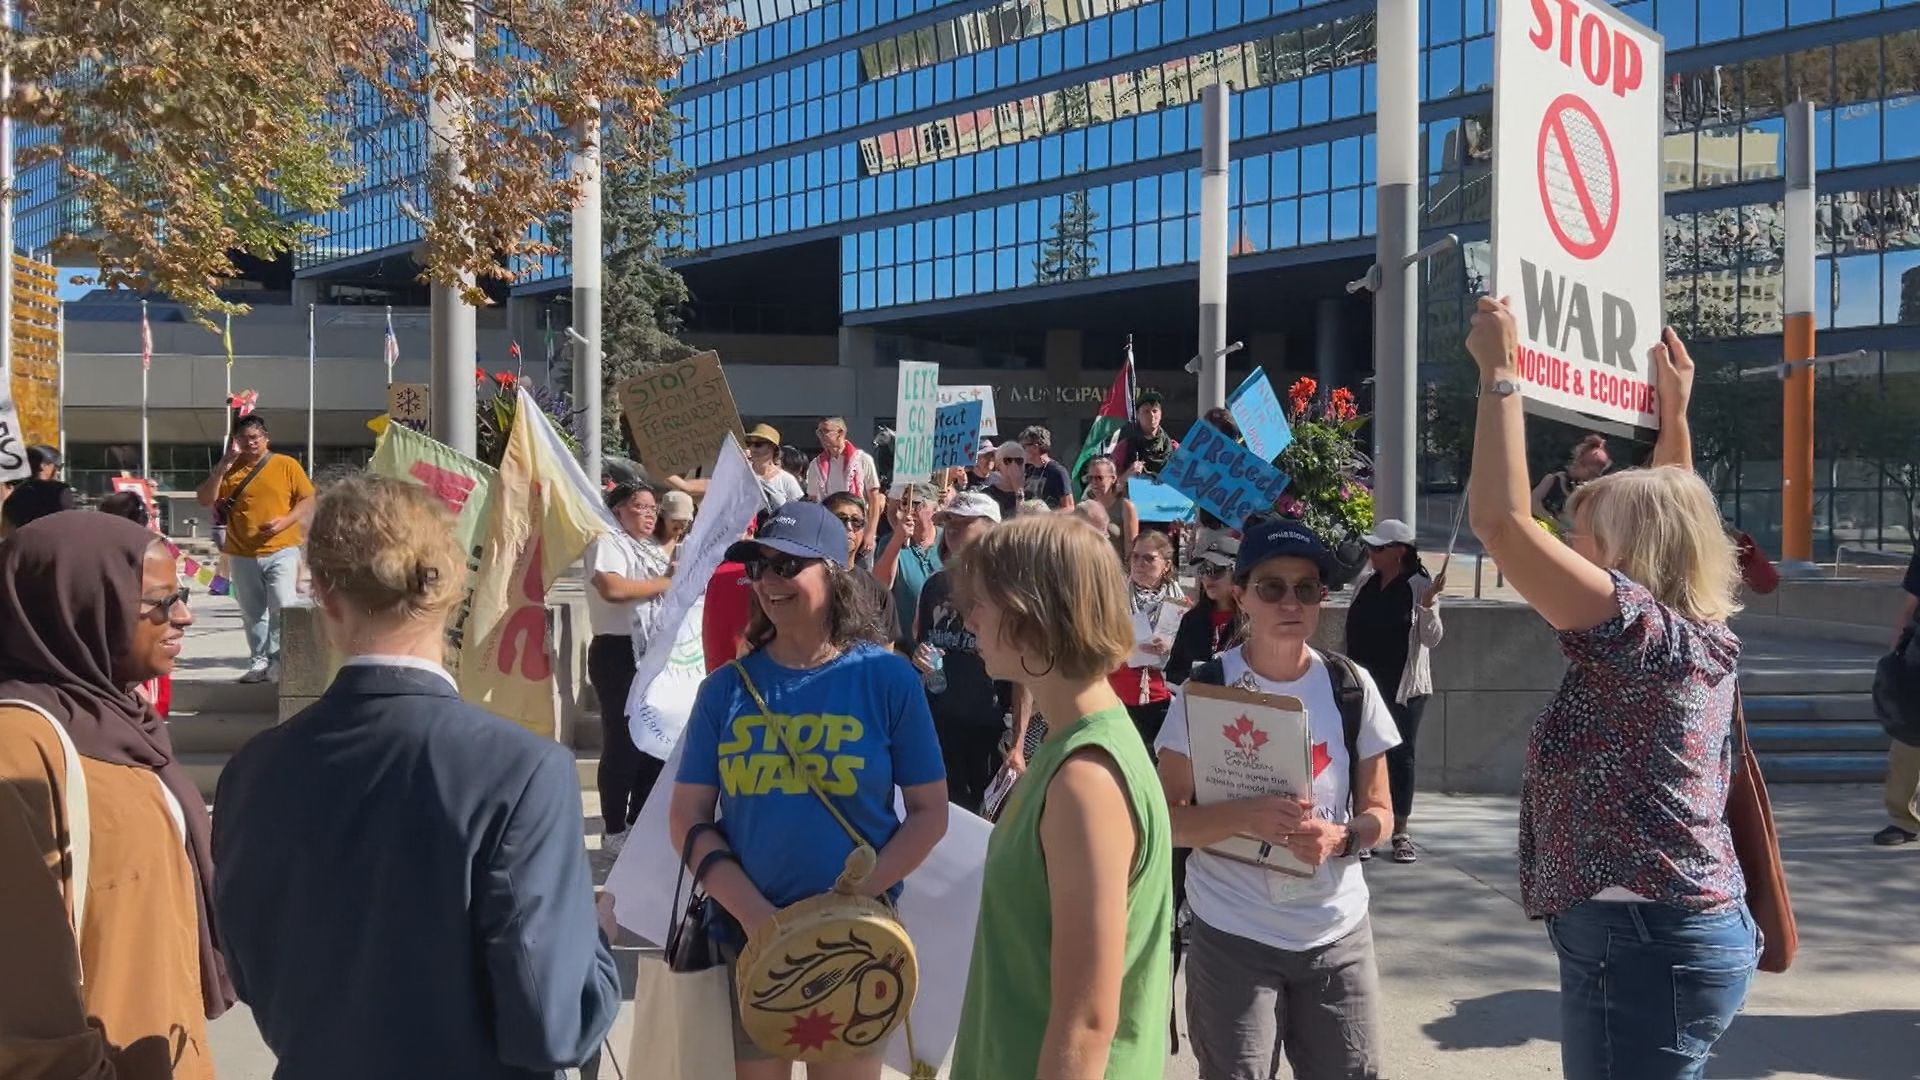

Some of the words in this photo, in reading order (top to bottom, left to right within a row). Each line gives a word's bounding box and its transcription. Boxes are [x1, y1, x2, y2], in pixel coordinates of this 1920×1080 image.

[1528, 0, 1643, 98] STOP
[1519, 257, 1637, 372] WAR
[628, 364, 697, 411] STOP
[904, 369, 937, 400] LET'S
[1516, 344, 1570, 394] NOCIDE
[1572, 369, 1585, 397] &
[1589, 369, 1656, 414] ECOCIDE
[909, 406, 925, 433] GO
[934, 431, 965, 448] ther
[935, 408, 967, 429] tect
[895, 436, 933, 474] SOLAR
[933, 447, 958, 468] rth
[1179, 459, 1253, 520] Wate
[718, 713, 864, 756] STOP
[718, 753, 865, 797] WARS
